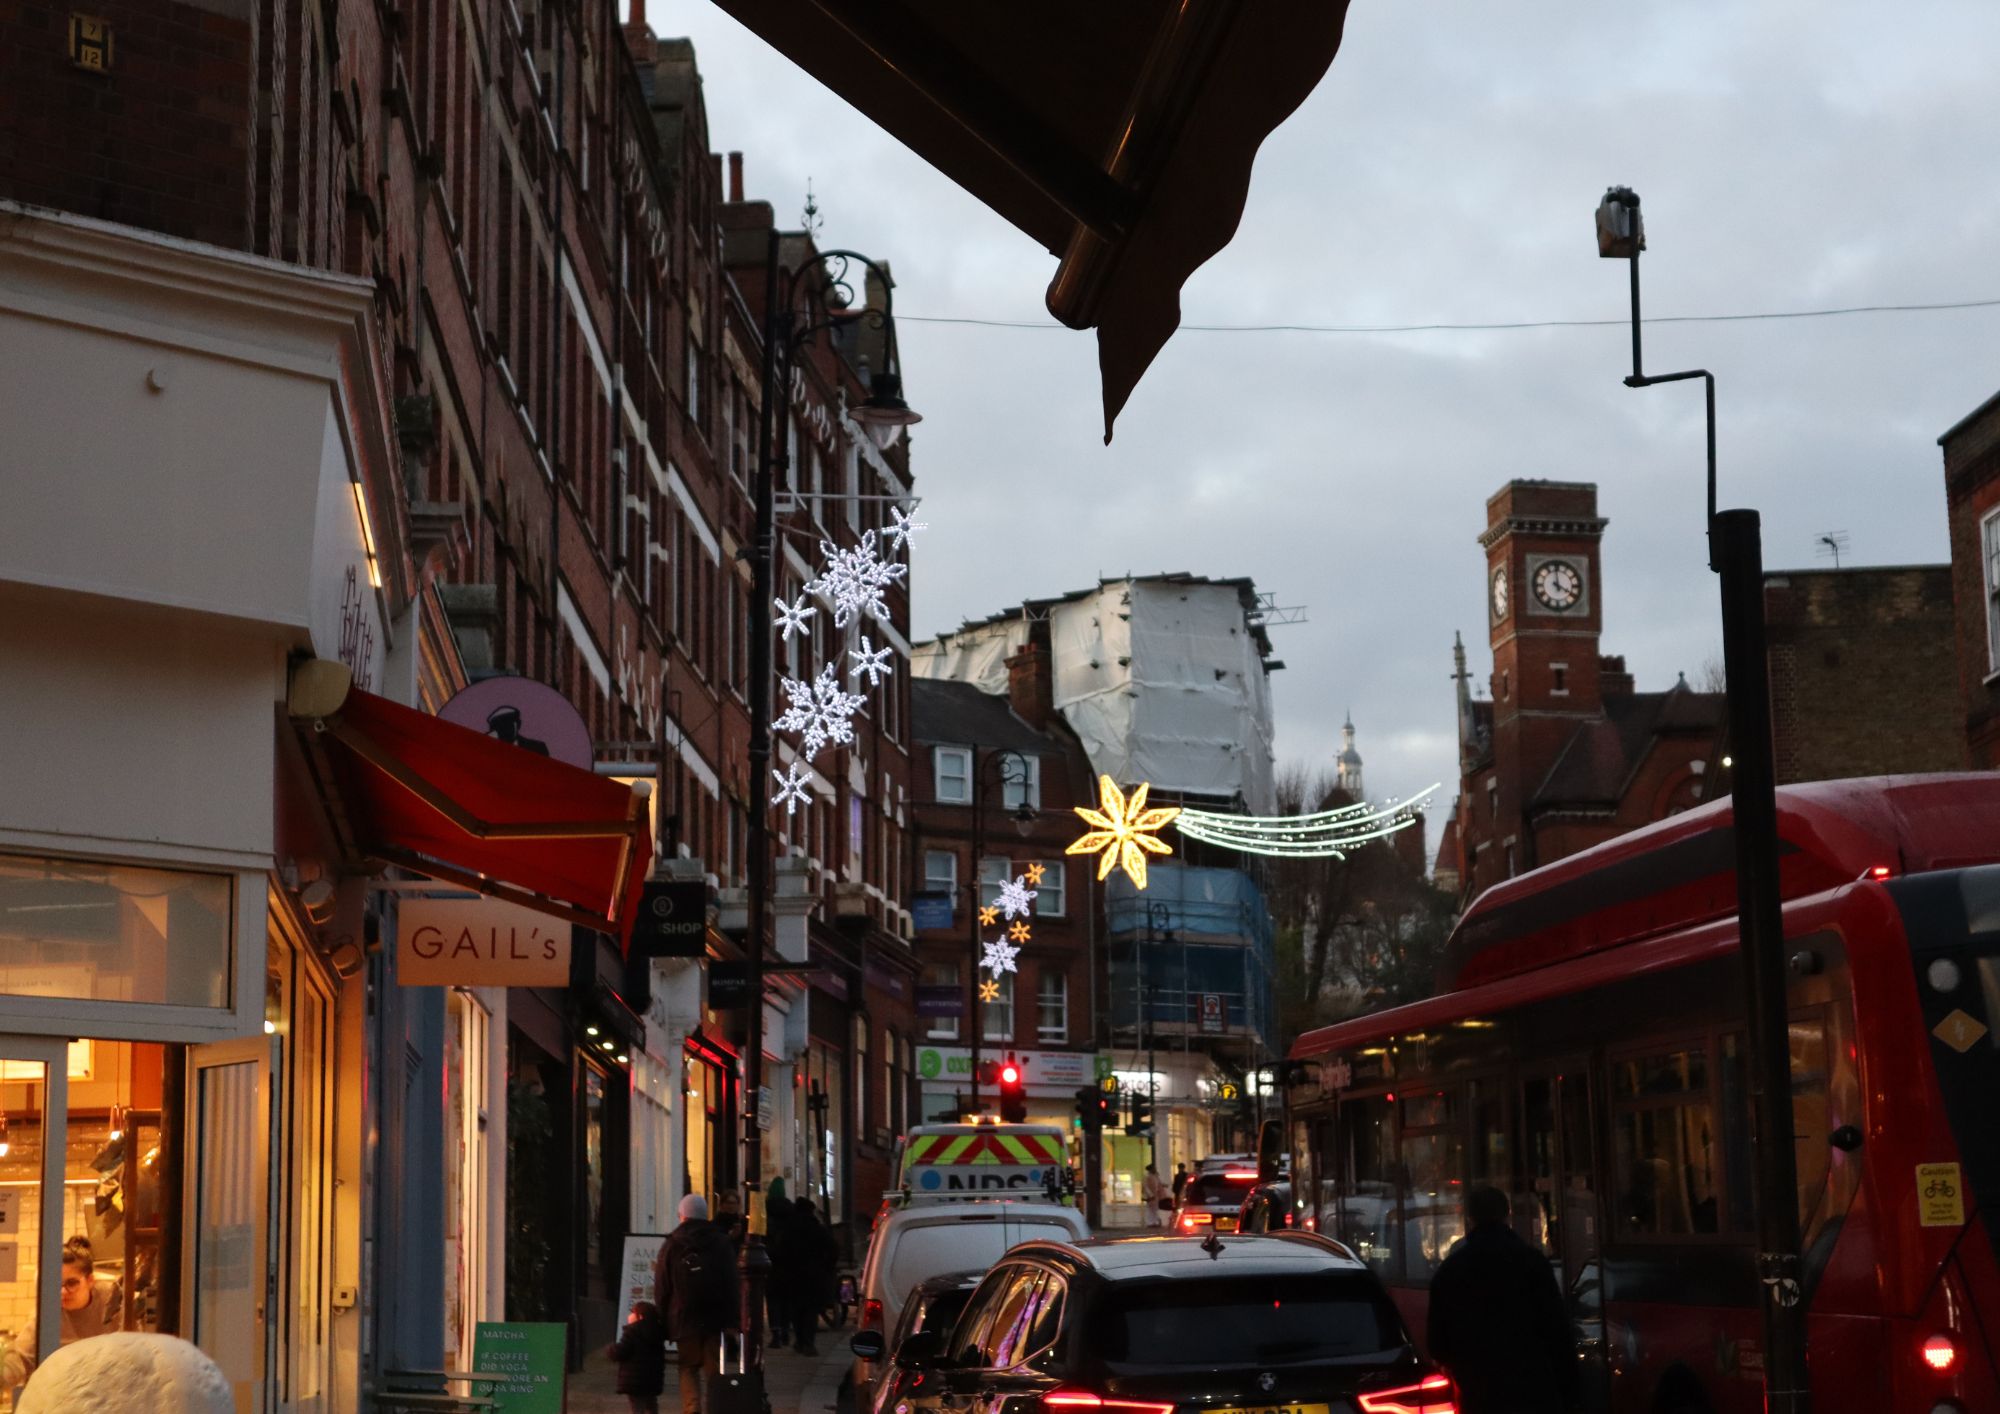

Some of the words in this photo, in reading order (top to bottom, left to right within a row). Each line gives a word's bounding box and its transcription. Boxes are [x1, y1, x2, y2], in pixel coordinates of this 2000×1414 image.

[84, 50, 99, 65] 12
[412, 926, 556, 959] GAIL's
[946, 1056, 975, 1073] OXF
[1117, 1080, 1161, 1092] oxtons
[492, 1352, 529, 1361] COFFEE
